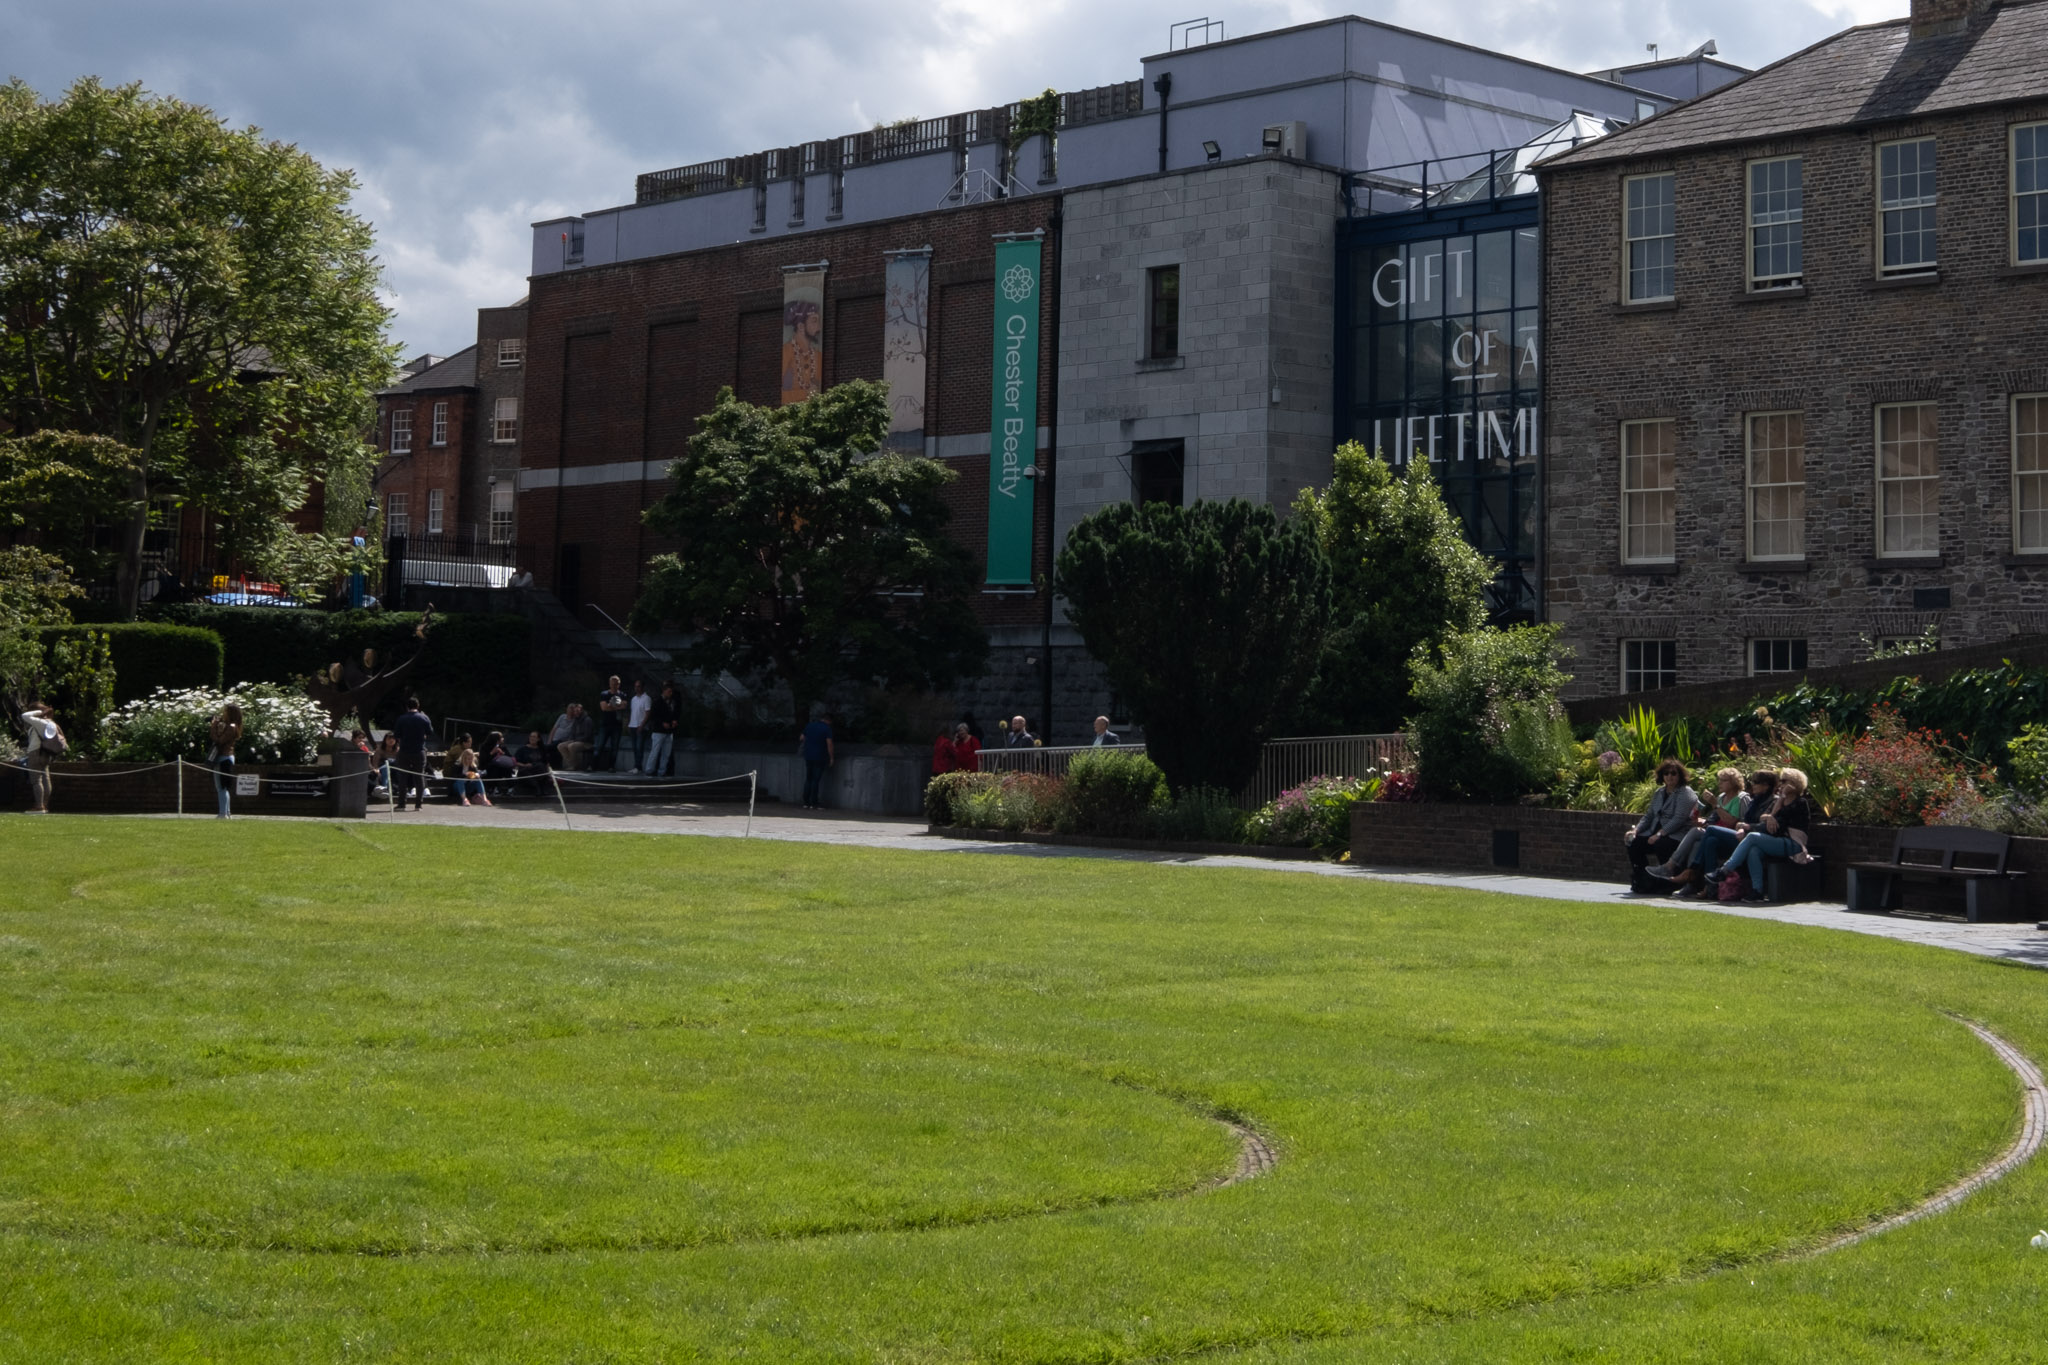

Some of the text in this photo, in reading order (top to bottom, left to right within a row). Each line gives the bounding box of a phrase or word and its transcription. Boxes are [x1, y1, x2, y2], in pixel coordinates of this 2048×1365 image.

[1372, 249, 1473, 308] GIFT
[1452, 329, 1538, 375] OF A
[998, 315, 1027, 499] Chester Beatty
